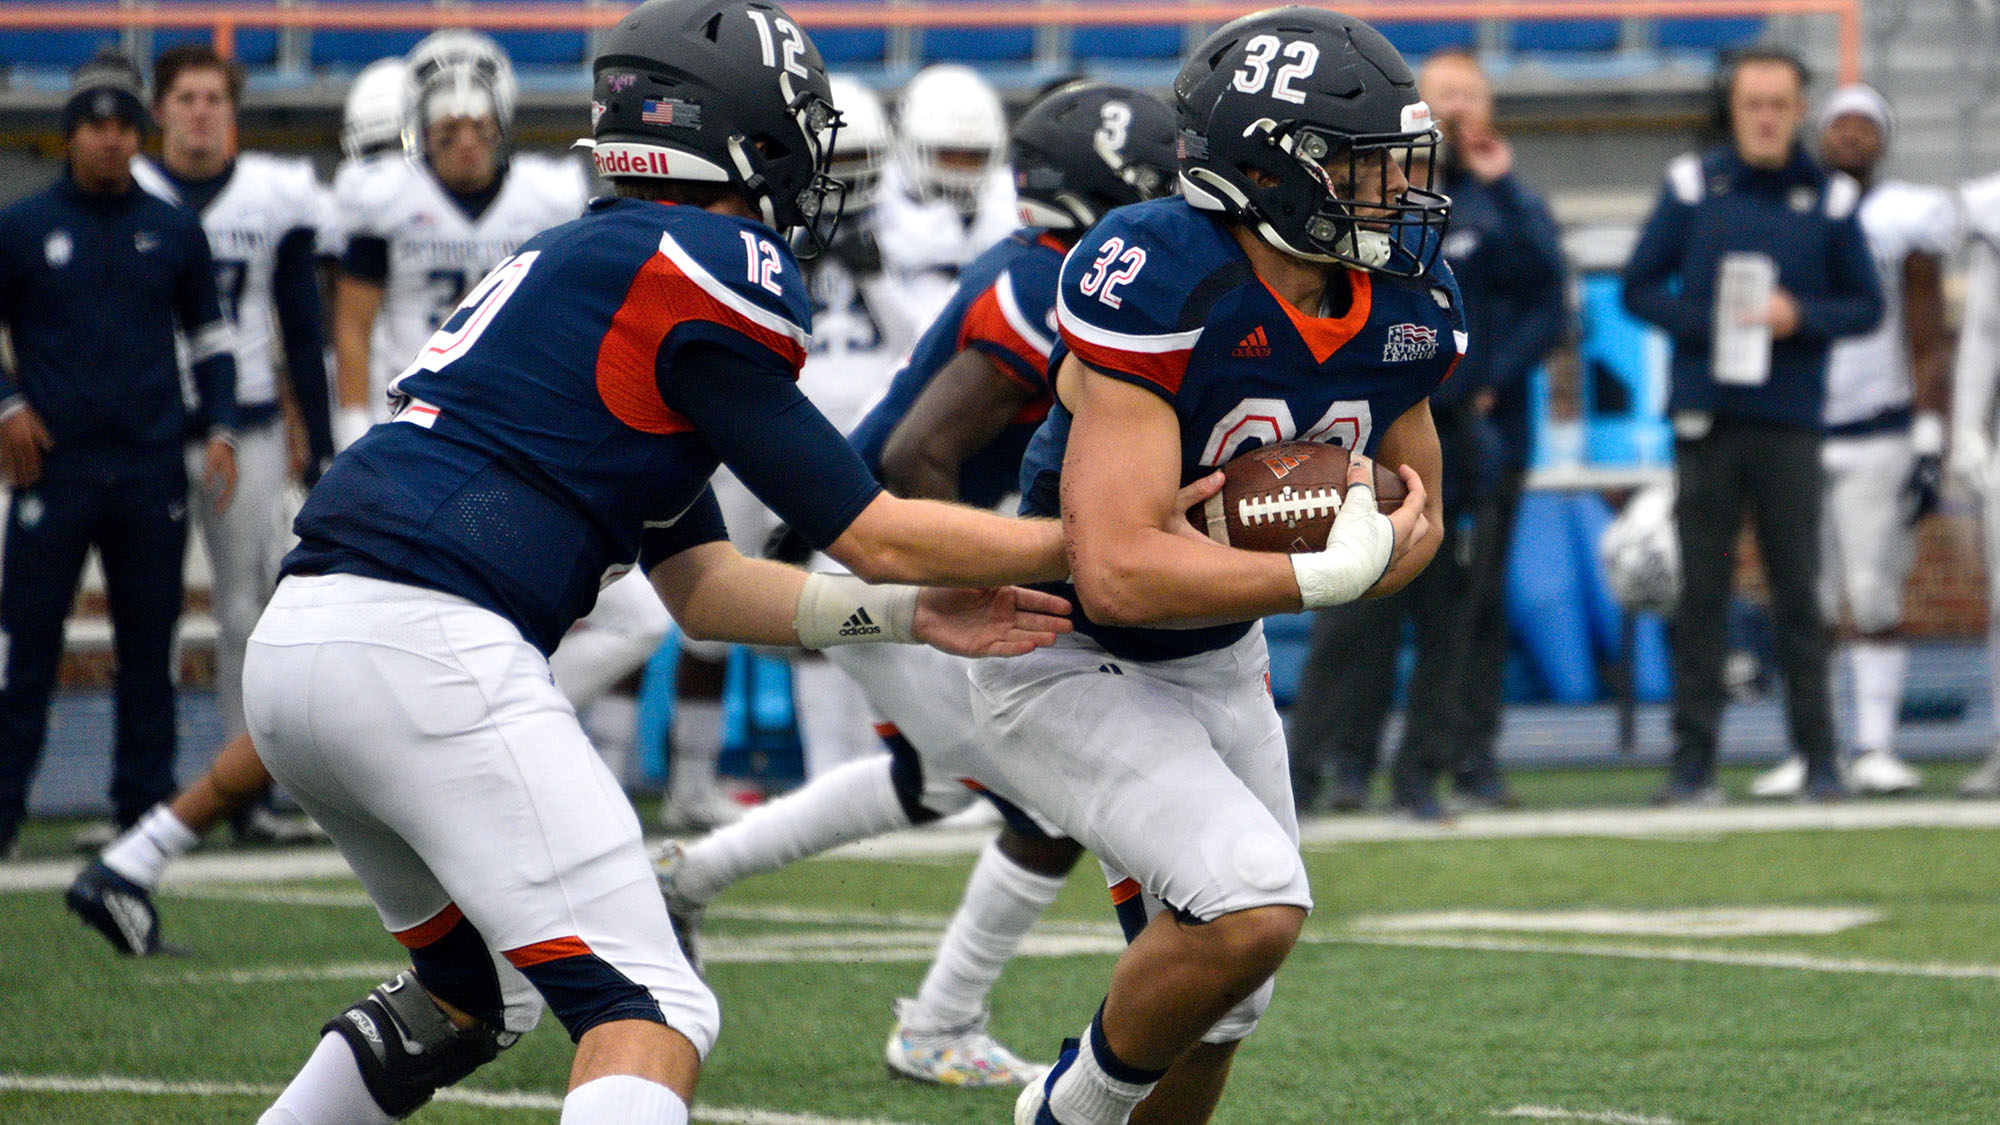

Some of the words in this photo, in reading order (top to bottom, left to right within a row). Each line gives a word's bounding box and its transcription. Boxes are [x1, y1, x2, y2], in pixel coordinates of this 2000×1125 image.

[746, 10, 808, 80] 12
[1232, 34, 1320, 105] 32
[1093, 101, 1132, 152] 3
[593, 150, 669, 175] Riddell
[739, 230, 782, 297] 12
[1080, 237, 1146, 310] 32
[1382, 350, 1436, 362] LEAGUE
[1383, 342, 1439, 354] PATRIOT
[838, 625, 881, 636] adidas
